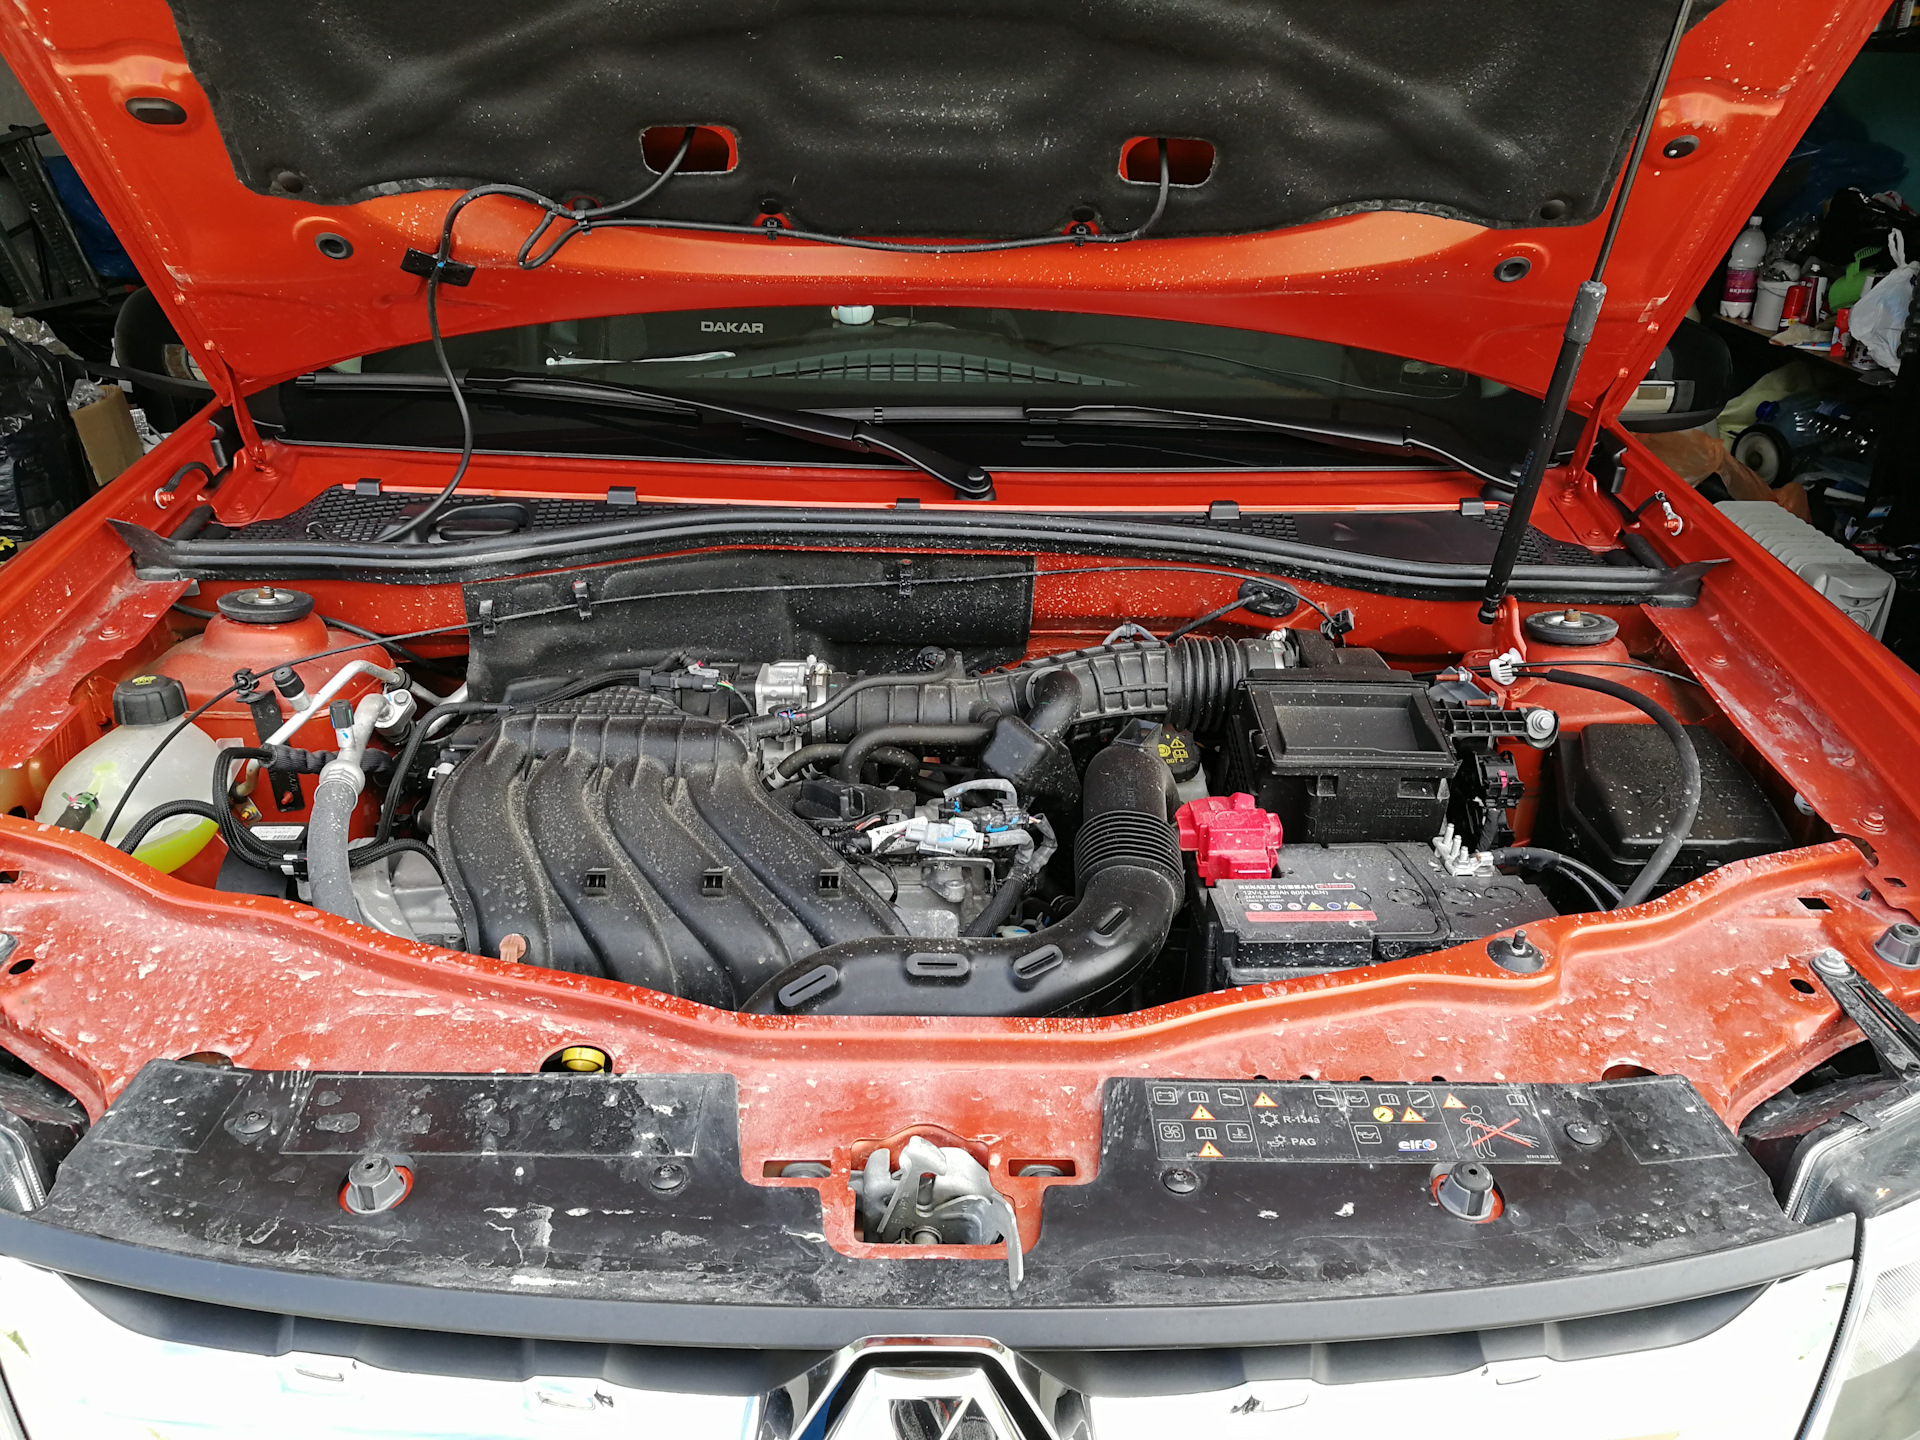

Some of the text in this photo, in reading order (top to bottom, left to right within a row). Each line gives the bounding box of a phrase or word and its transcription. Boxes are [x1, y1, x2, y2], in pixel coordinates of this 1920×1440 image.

[700, 320, 764, 334] DAKAR
[1282, 1114, 1320, 1124] R-134a
[1290, 1137, 1317, 1146] PAG
[1399, 1139, 1424, 1150] elf
